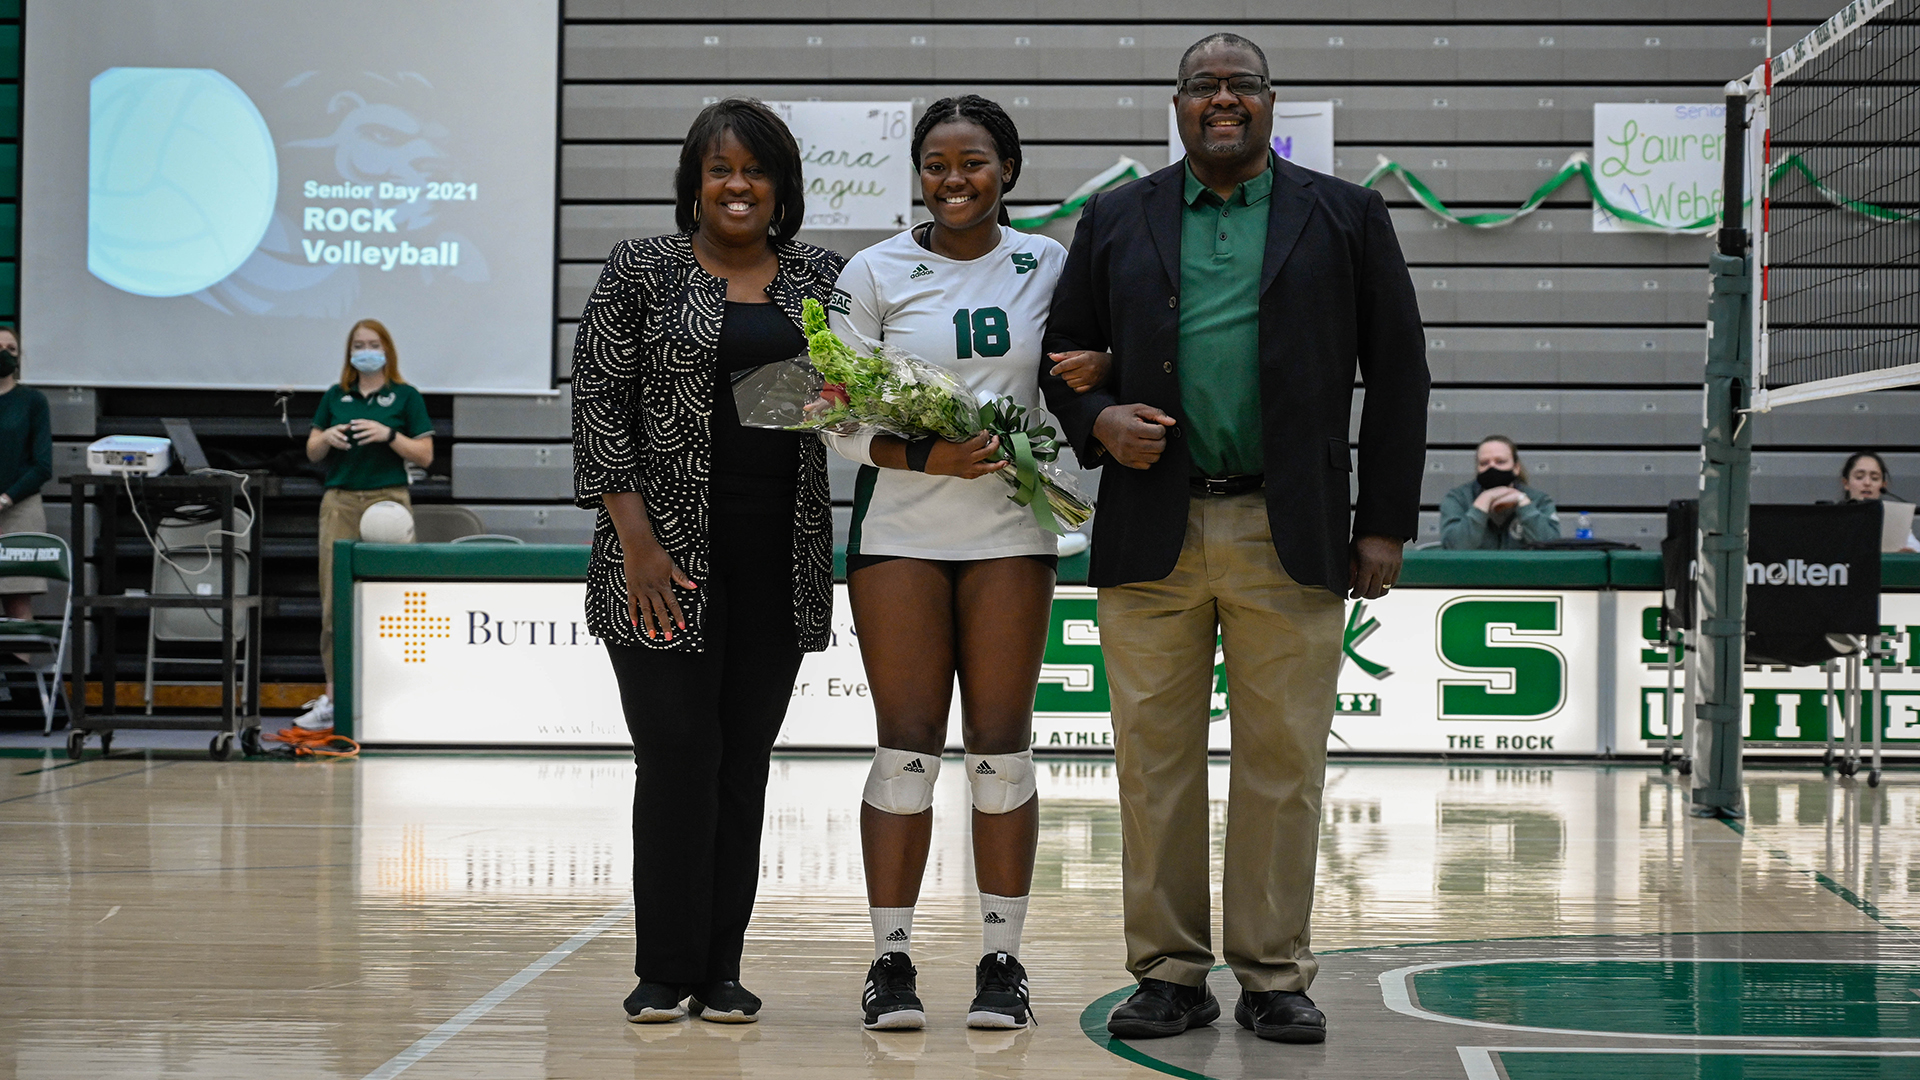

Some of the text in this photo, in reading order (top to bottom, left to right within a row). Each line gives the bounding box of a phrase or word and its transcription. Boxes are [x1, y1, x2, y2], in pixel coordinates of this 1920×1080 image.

[796, 138, 891, 168] iara
[304, 180, 478, 203] Senior Day 2021
[804, 177, 886, 210] ague
[1642, 182, 1725, 221] Webe
[304, 206, 398, 233] ROCK
[302, 238, 459, 271] Volleyball
[910, 269, 934, 280] adidas
[831, 293, 852, 311] SAC
[953, 306, 1011, 360] 18
[466, 610, 600, 646] BUTLE
[1436, 595, 1567, 721] S
[828, 678, 868, 697] Eve
[1050, 731, 1112, 745] ATHLE
[1446, 735, 1555, 750] THE ROCK
